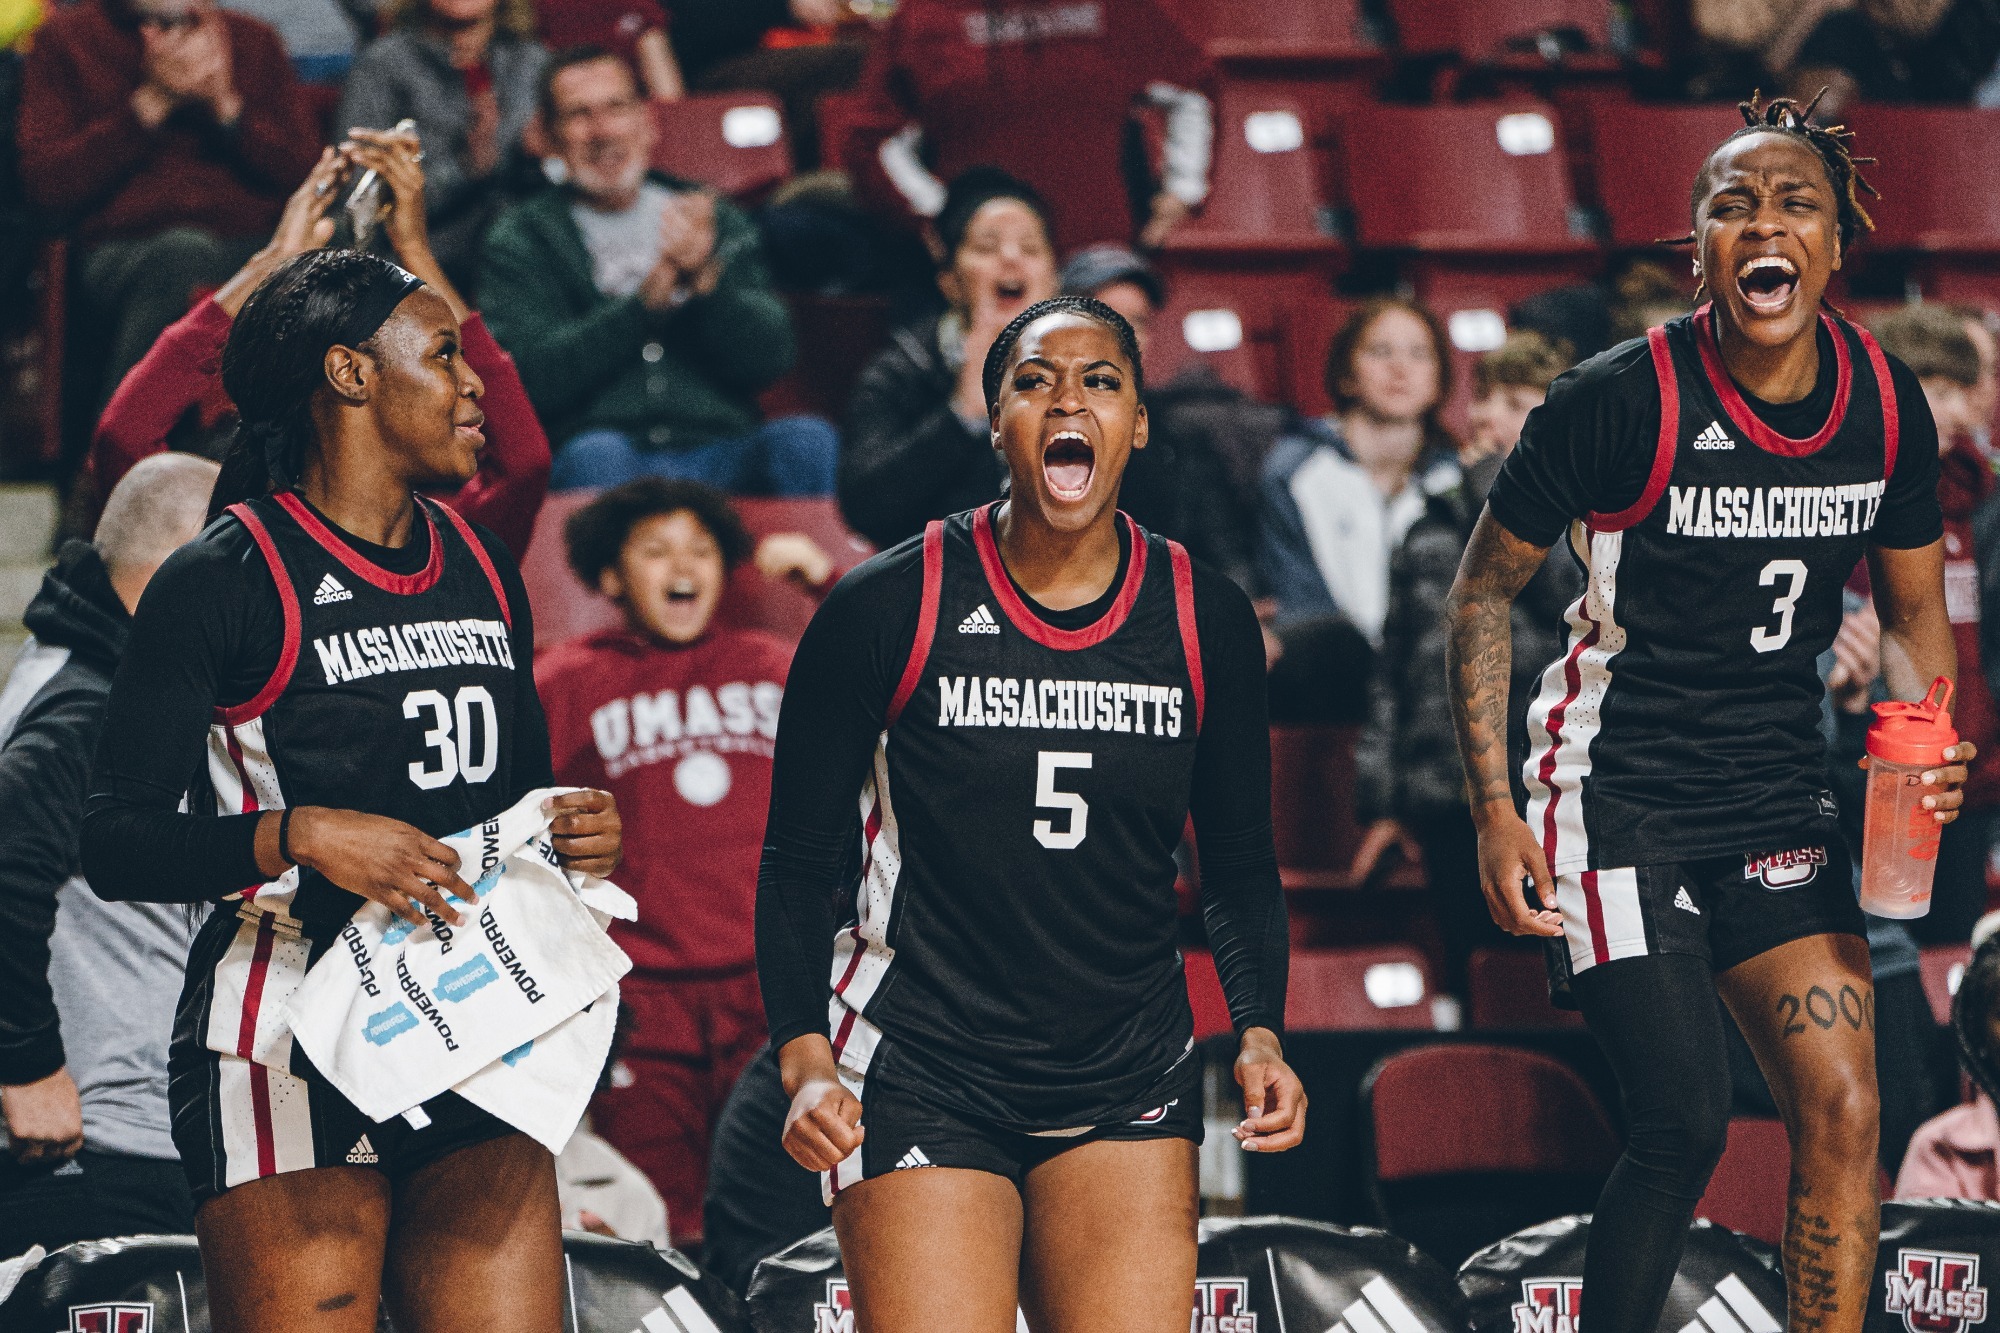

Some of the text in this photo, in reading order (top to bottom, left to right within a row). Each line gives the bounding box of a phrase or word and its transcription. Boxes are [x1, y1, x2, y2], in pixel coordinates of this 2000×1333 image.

[1693, 438, 1735, 450] adidas
[314, 588, 353, 605] adidas
[1750, 560, 1808, 653] 3
[958, 622, 1000, 634] adidas
[938, 676, 1183, 737] MASSACHUSETTS
[402, 686, 498, 790] 30
[1033, 751, 1092, 849] 5
[345, 1152, 379, 1164] adidas
[1886, 1271, 1988, 1322] MASS
